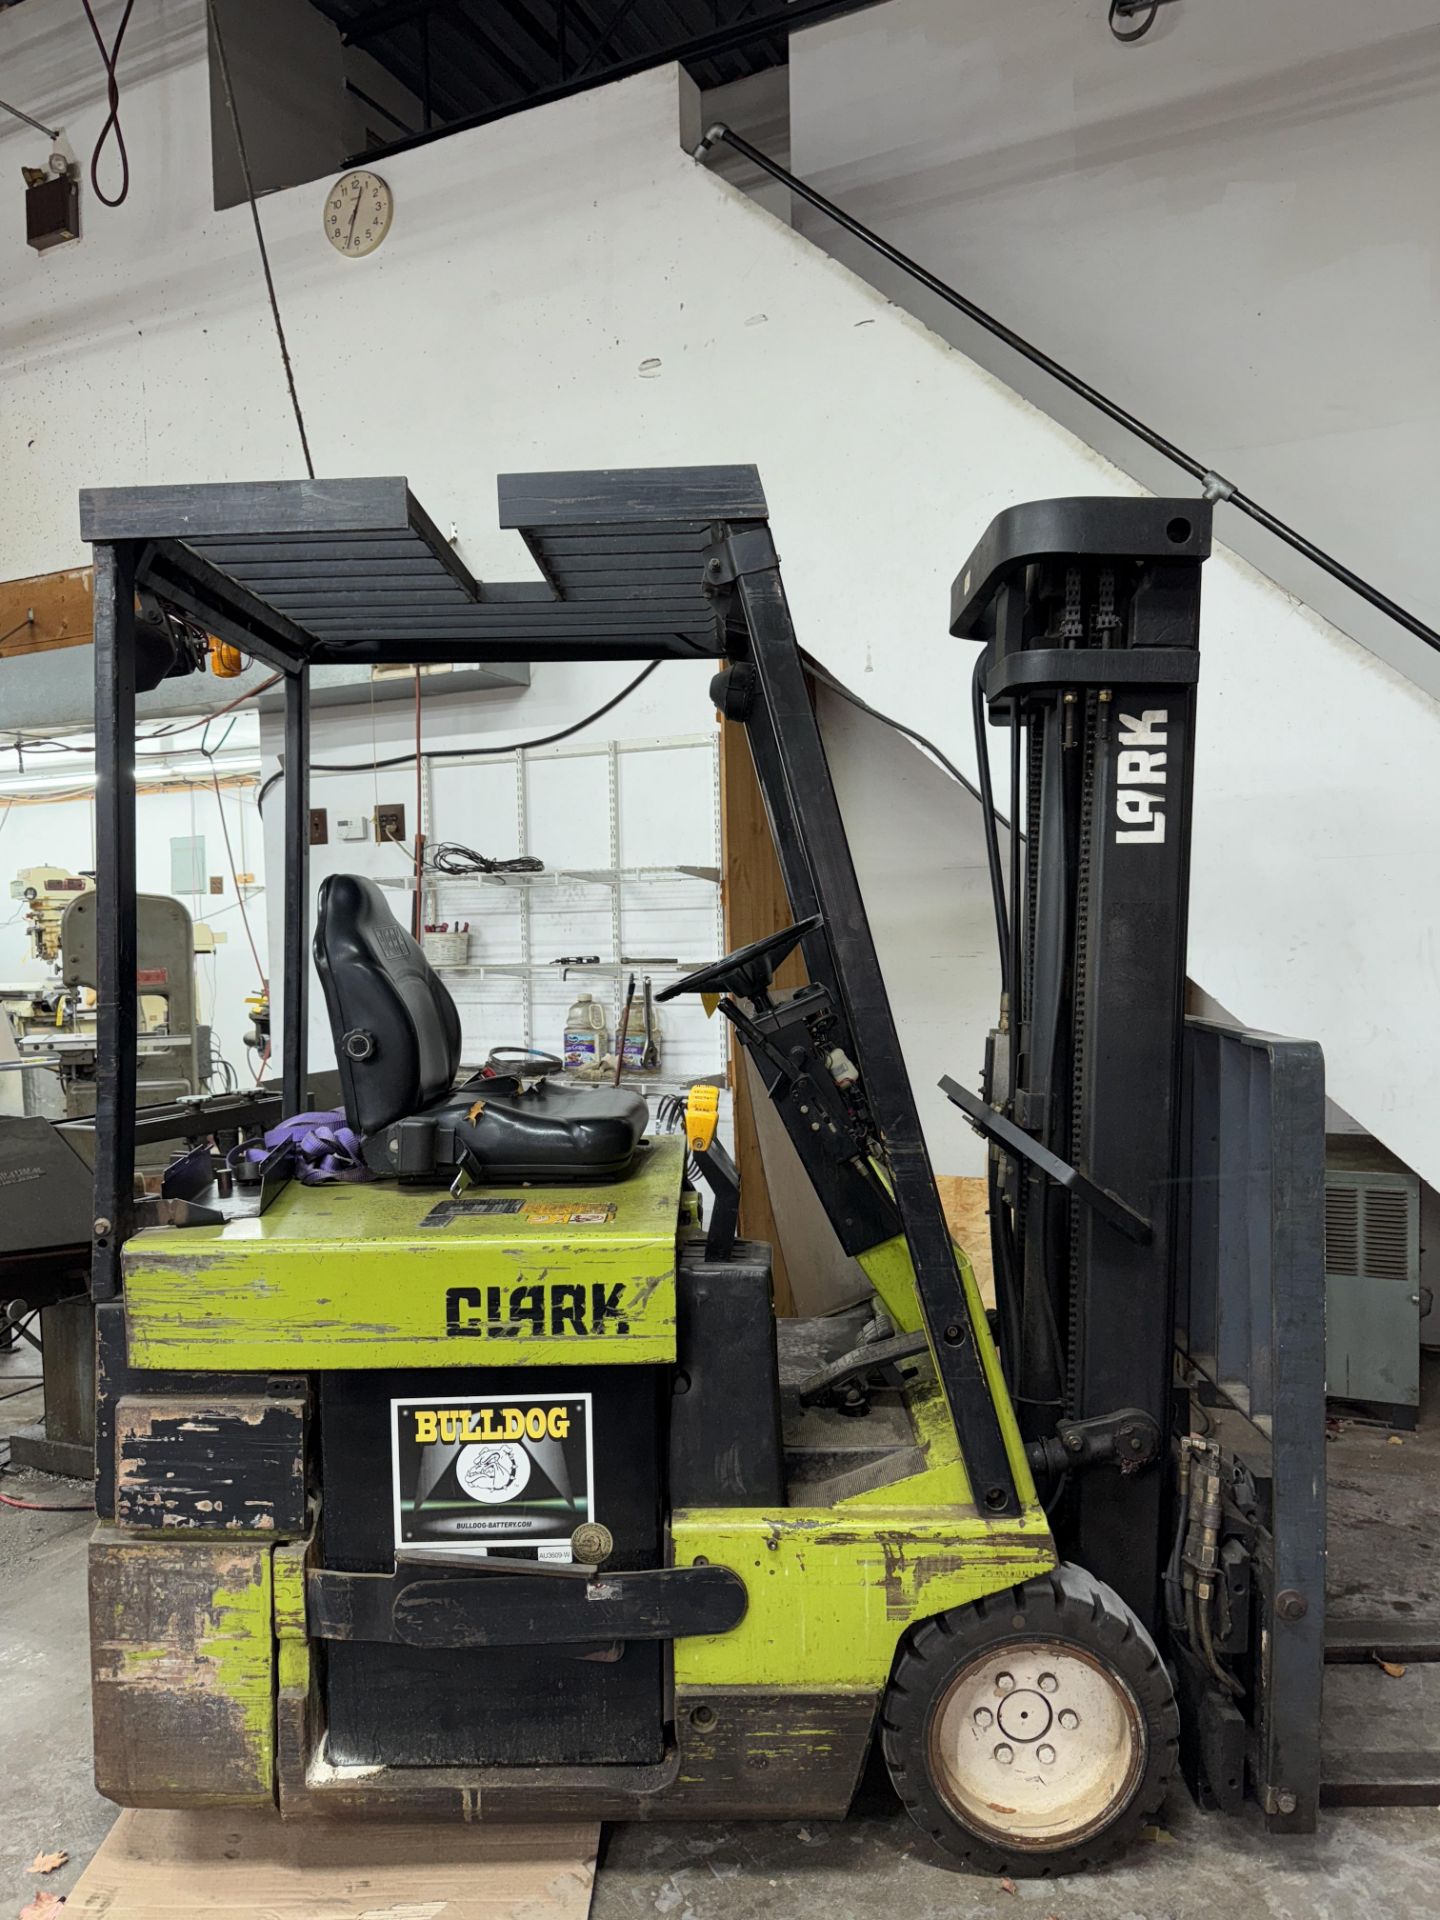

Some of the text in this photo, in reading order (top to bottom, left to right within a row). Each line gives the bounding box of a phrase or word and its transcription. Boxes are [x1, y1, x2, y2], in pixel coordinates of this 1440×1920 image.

[351, 180, 360, 190] 12
[341, 188, 348, 196] 11
[372, 188, 379, 198] 2
[333, 200, 342, 210] 10
[375, 202, 382, 211] 3
[331, 215, 337, 225] 9
[372, 216, 379, 226] 4
[334, 228, 341, 238] 8
[365, 229, 372, 239] 5
[353, 236, 361, 246] 6
[445, 1283, 630, 1338] CLARK
[415, 1406, 570, 1443] BULLDOG
[456, 1521, 532, 1529] BULLDOG-BATTERY.COM
